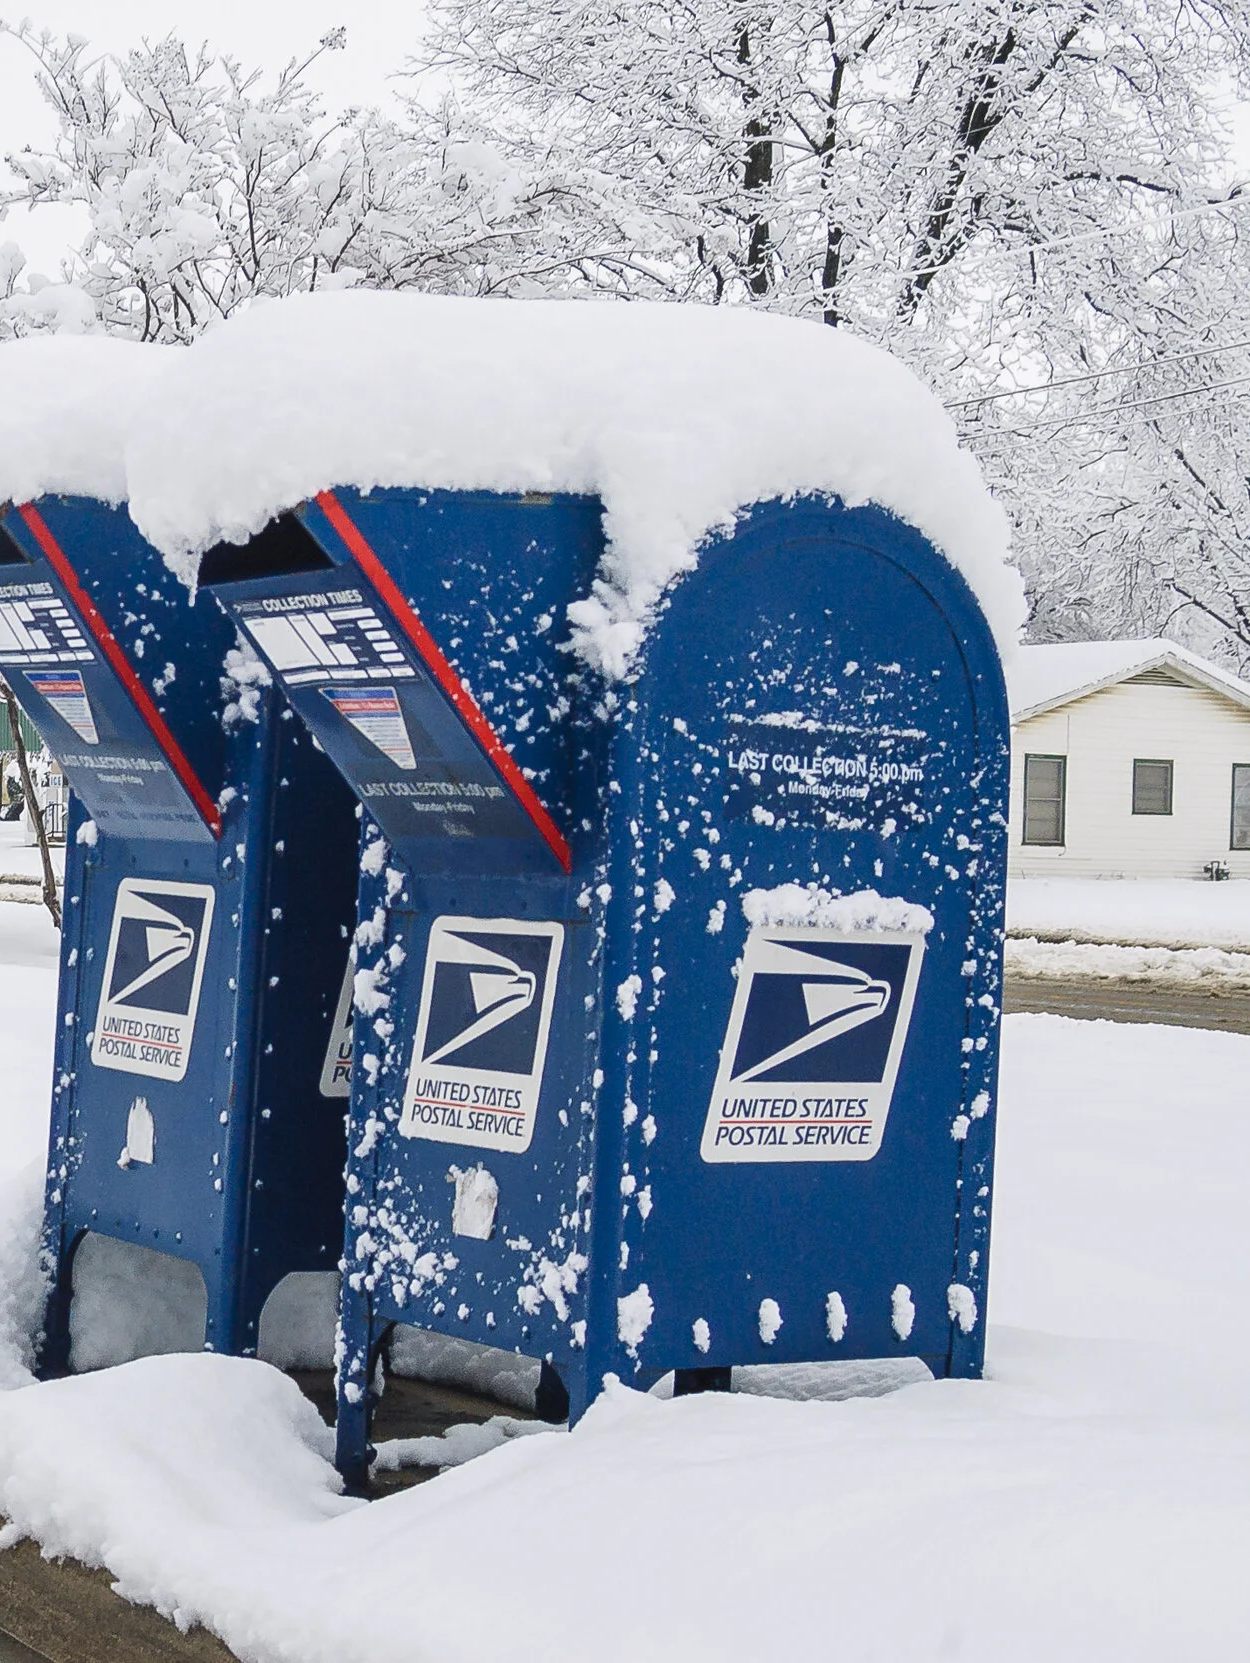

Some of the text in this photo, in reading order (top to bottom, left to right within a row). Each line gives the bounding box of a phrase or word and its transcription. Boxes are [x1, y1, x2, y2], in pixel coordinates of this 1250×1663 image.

[27, 582, 53, 595] TIMES
[262, 594, 327, 612] COLLECTION
[327, 590, 363, 605] TIMES
[728, 751, 769, 771] LAST
[772, 754, 868, 778] COLLECTION
[50, 775, 61, 786] ICE
[360, 783, 387, 797] LAST
[389, 783, 461, 796] COLLECTION
[103, 1016, 181, 1044] UNITED STATES
[99, 1038, 182, 1068] POSTAL SERVICE
[416, 1078, 522, 1109] UNITED STATES
[721, 1098, 868, 1118] UNITED STATES
[411, 1104, 525, 1137] POSTAL SERVICE
[715, 1125, 872, 1146] POSTAL SERVICE
